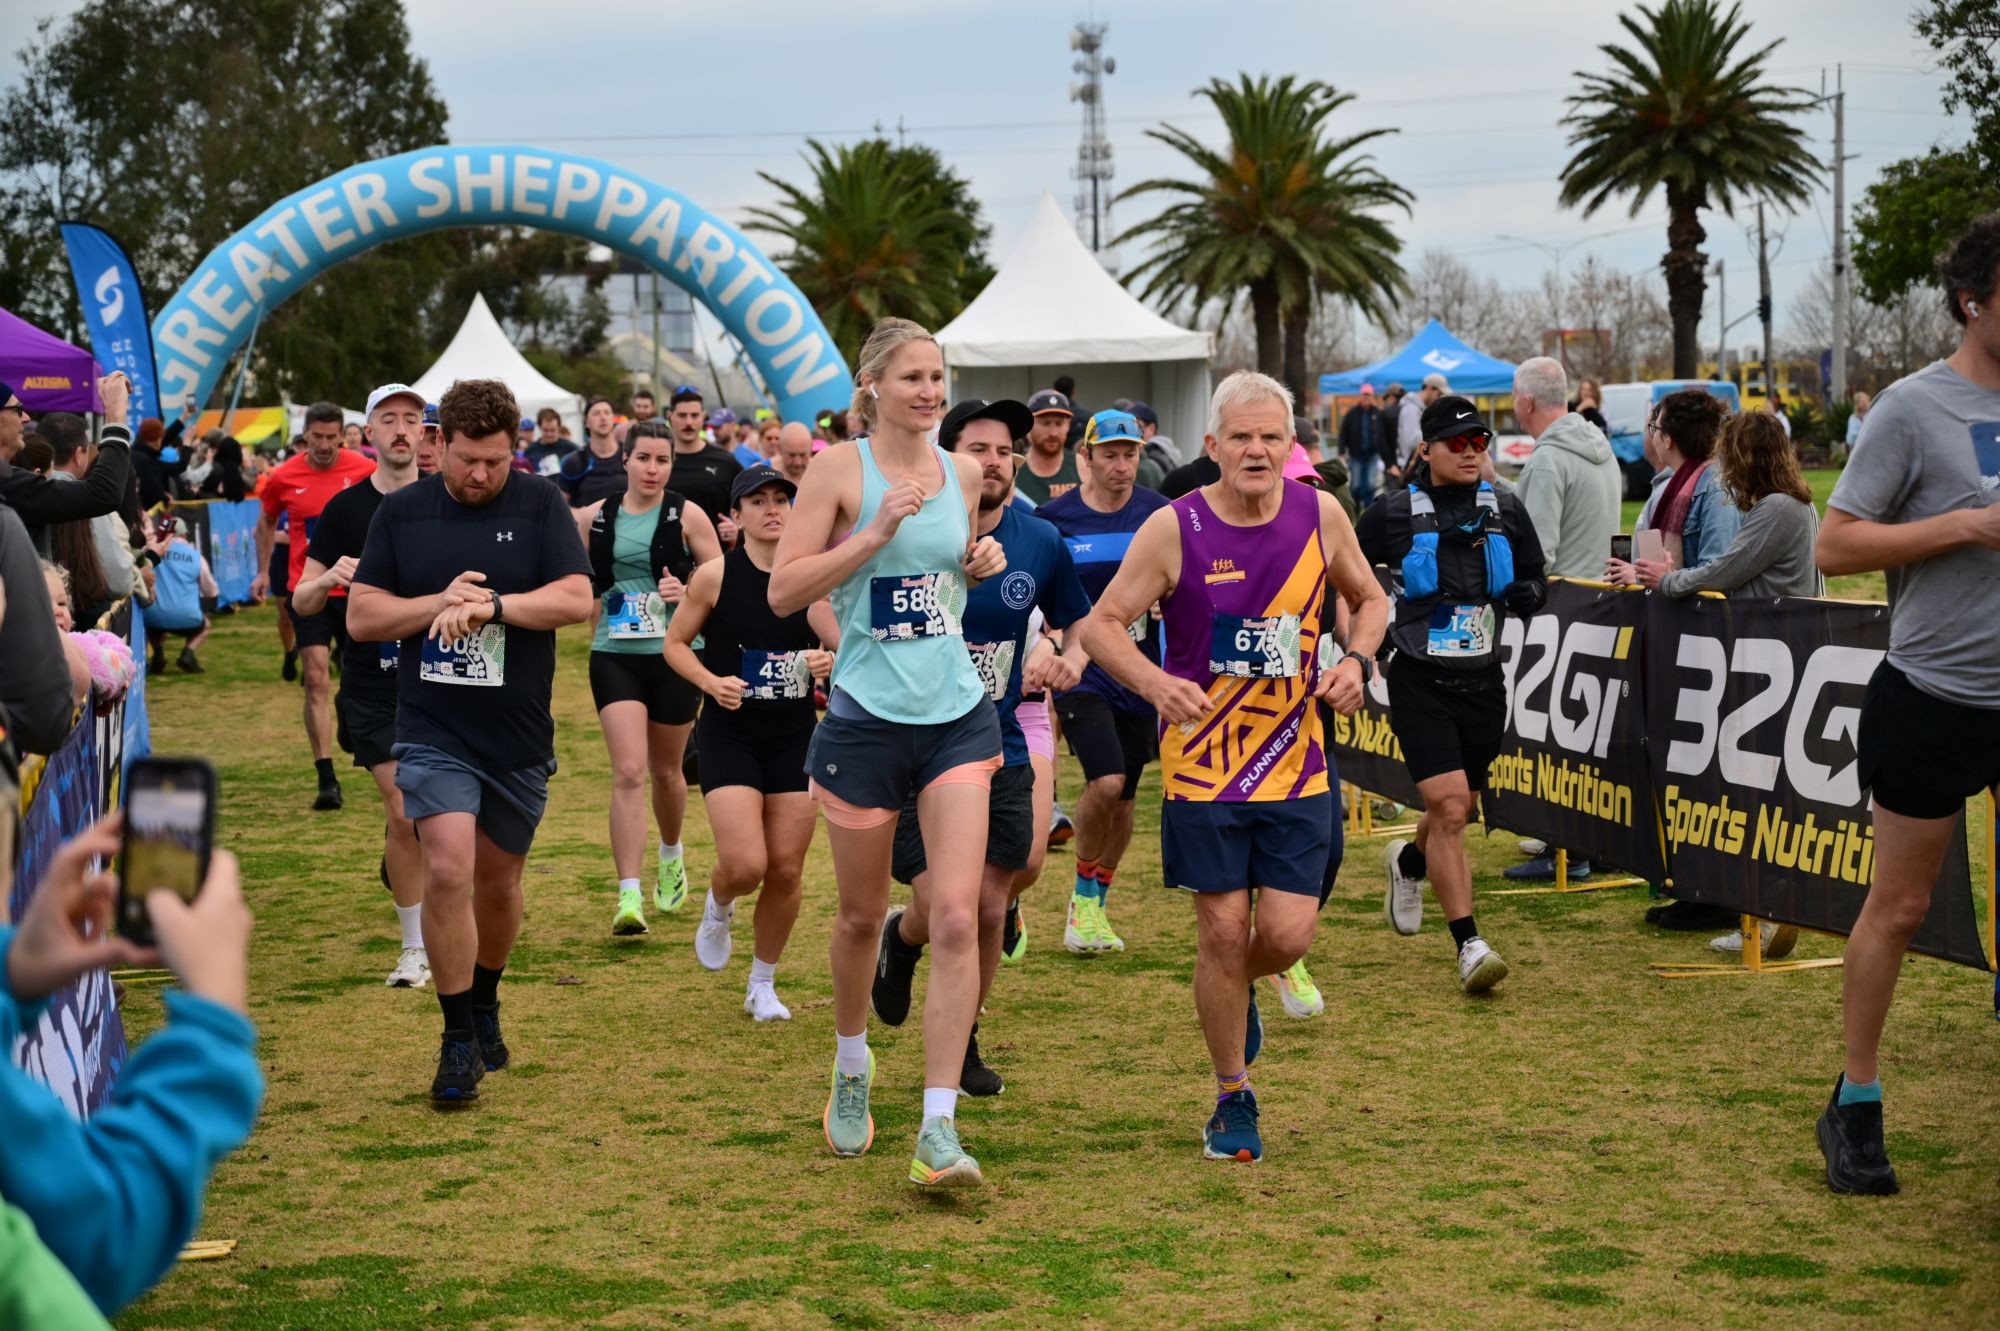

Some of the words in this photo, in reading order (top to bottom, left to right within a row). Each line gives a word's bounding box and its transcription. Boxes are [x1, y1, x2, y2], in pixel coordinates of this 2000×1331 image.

[157, 172, 399, 411] GREATER
[407, 154, 840, 397] SHEPPARTON
[22, 376, 72, 390] ALTEGRA
[165, 550, 194, 563] EDIA
[892, 587, 940, 613] 588
[1235, 629, 1280, 653] 677
[1239, 716, 1300, 793] RUNNERS
[1537, 751, 1632, 828] Nutrition
[1665, 785, 1747, 854] Sports
[1751, 803, 1876, 886] Nutriti
